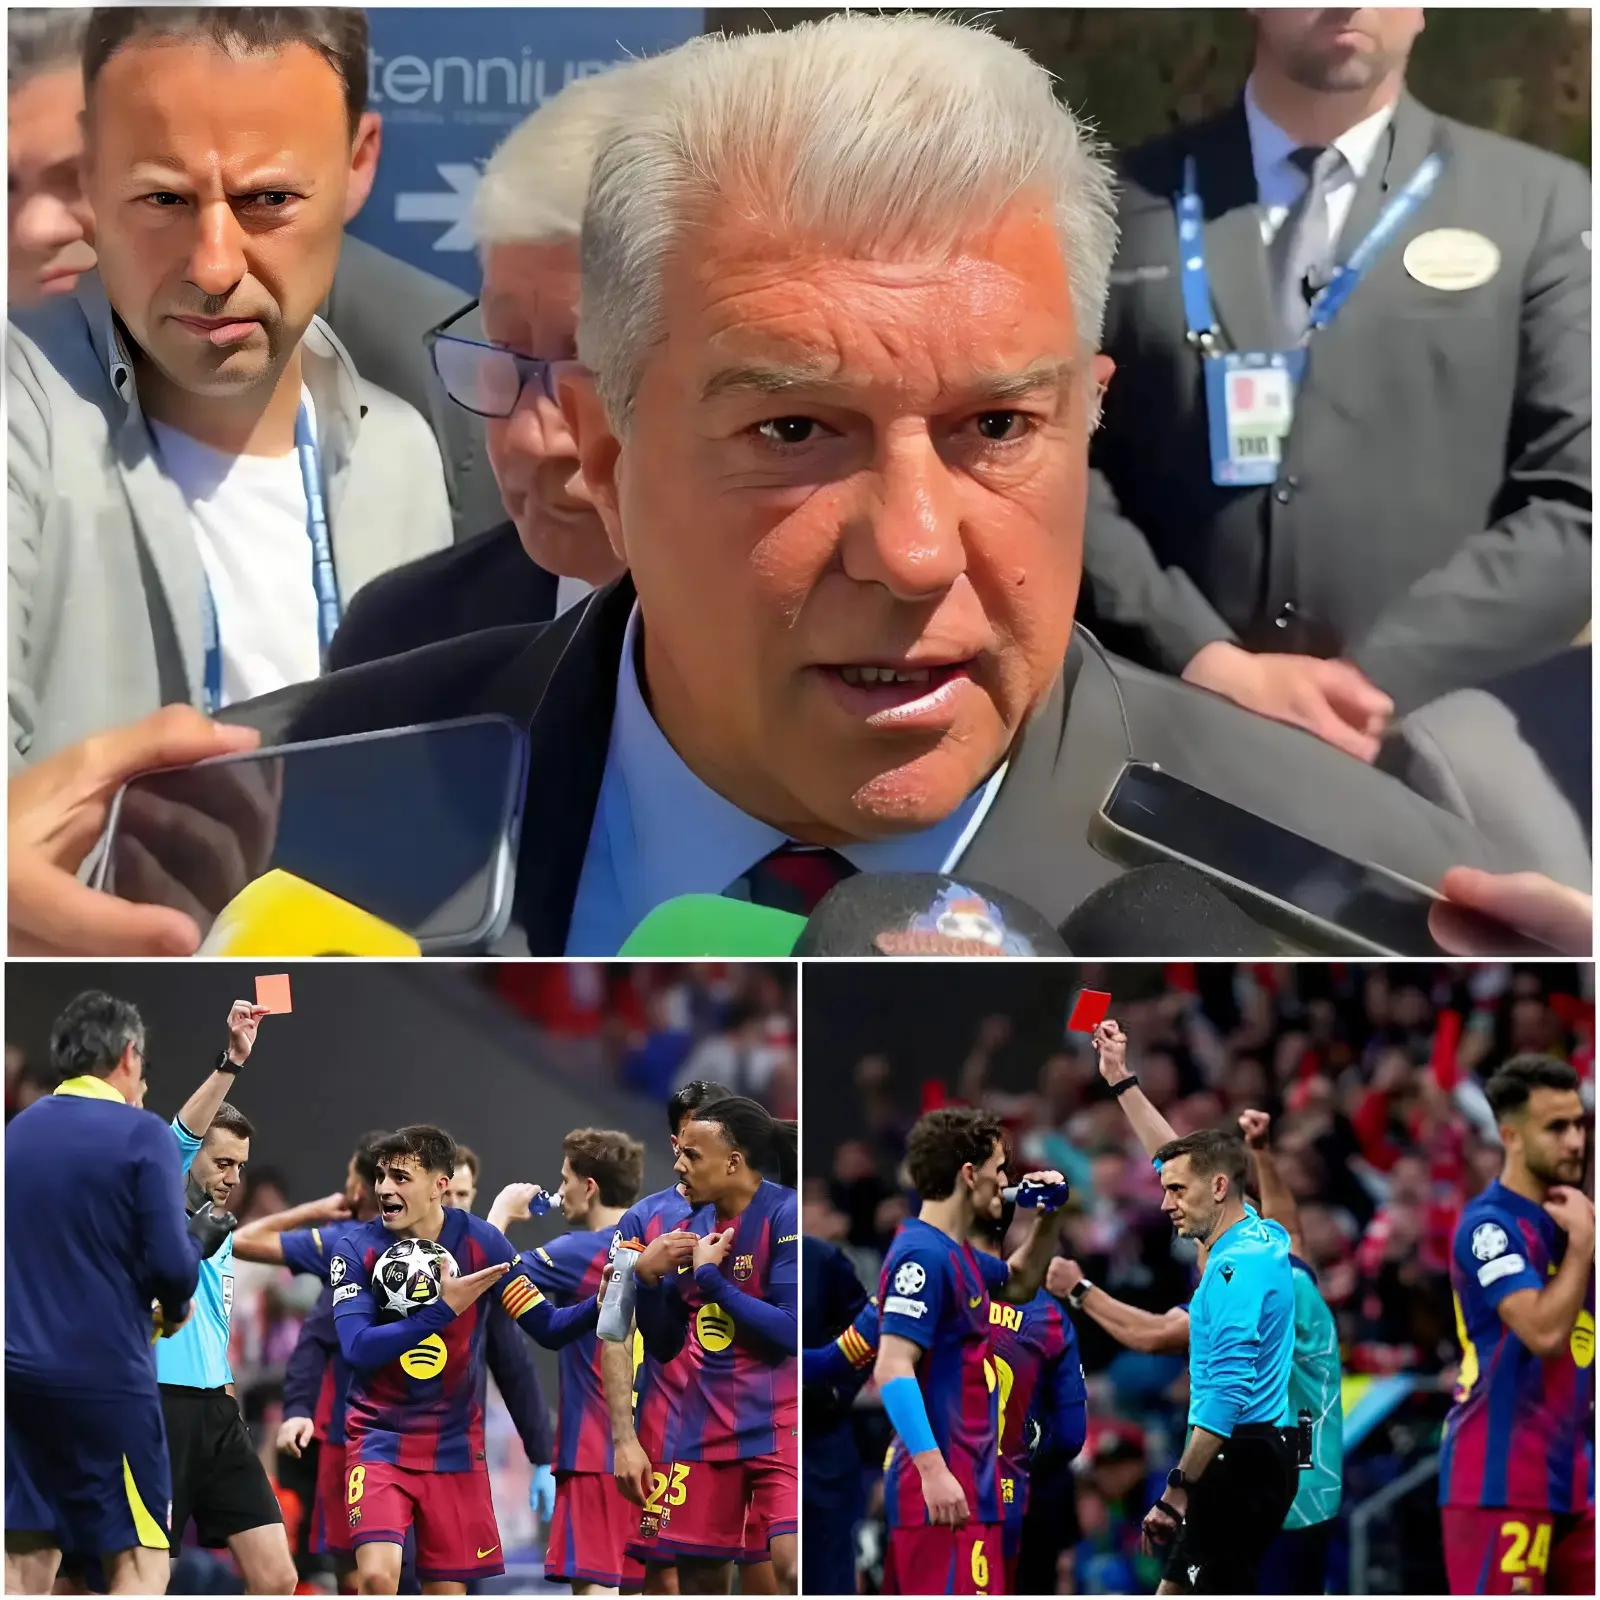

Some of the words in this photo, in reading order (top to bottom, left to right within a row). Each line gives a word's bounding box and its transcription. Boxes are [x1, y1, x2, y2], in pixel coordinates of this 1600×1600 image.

[989, 1301, 1024, 1332] DRI
[348, 1465, 366, 1505] 8
[971, 1539, 989, 1587] 6
[1501, 1520, 1552, 1576] 24
